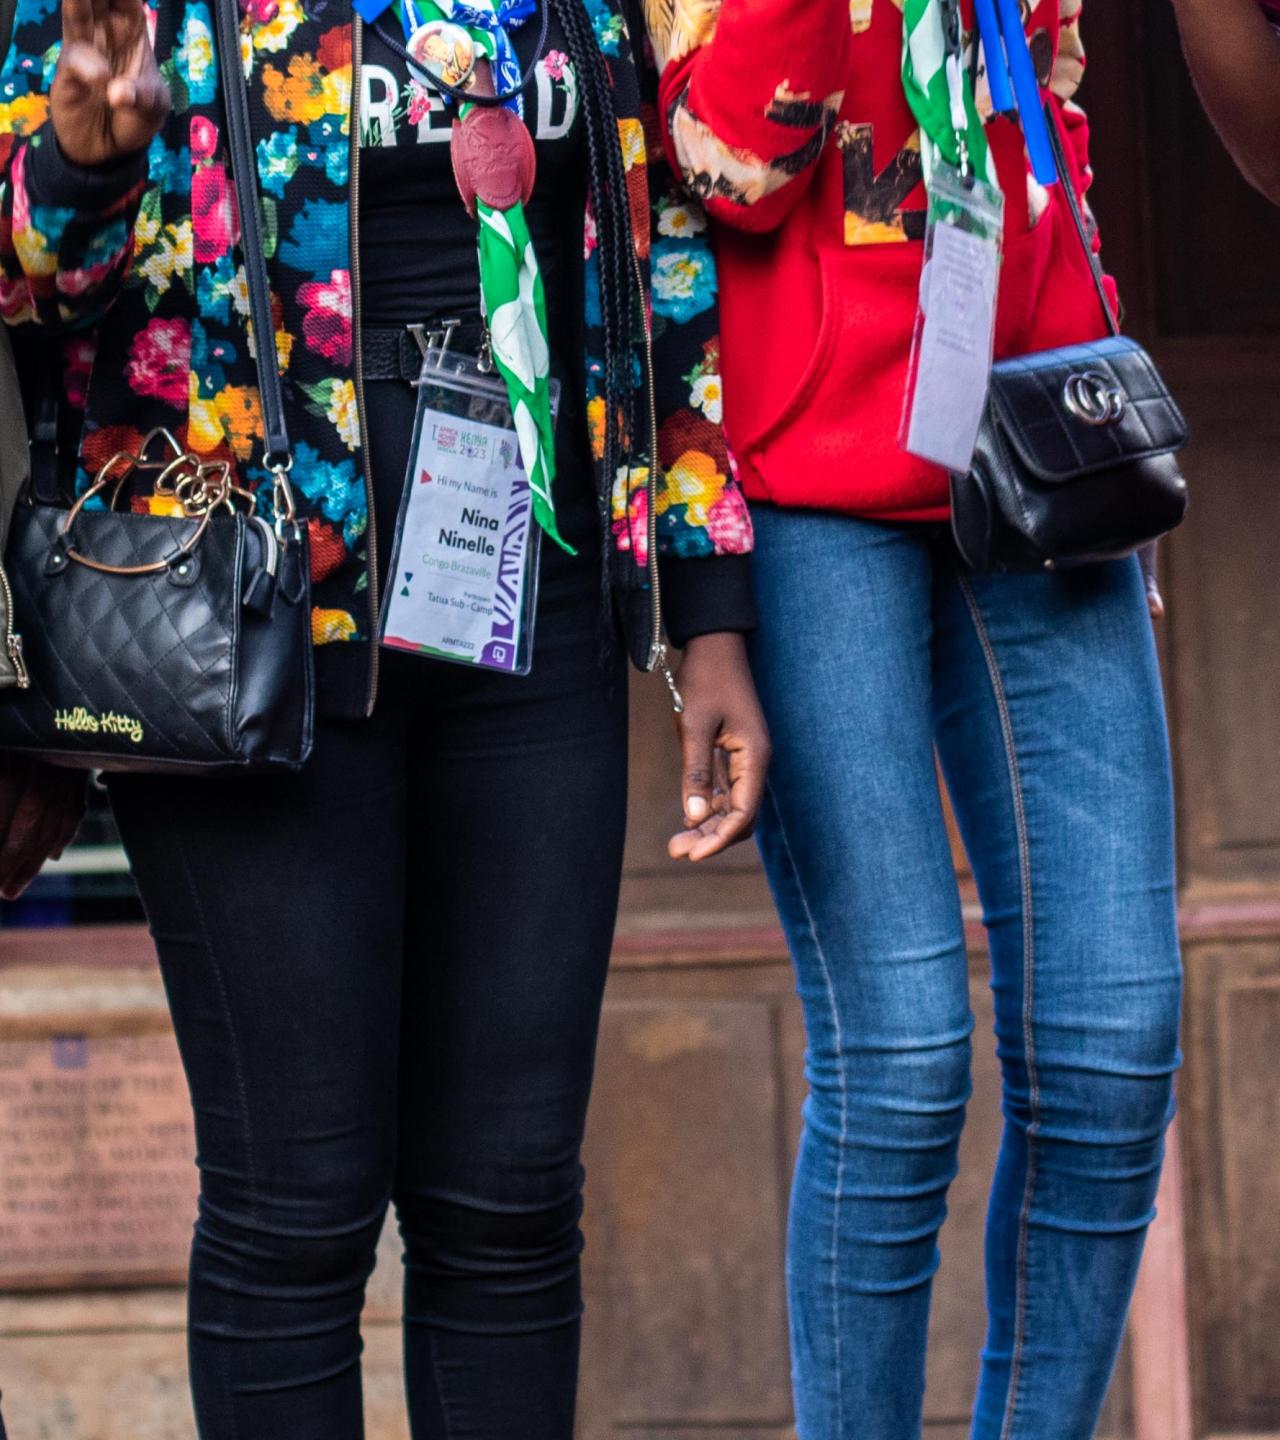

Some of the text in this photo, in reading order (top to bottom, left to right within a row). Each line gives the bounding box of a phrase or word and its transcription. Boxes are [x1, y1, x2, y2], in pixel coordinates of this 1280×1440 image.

[360, 59, 577, 148] RED
[460, 507, 500, 532] Nina
[438, 528, 496, 557] Ninelle
[422, 553, 451, 575] Congo
[470, 601, 494, 616] Camp
[54, 707, 144, 742] Hello Kitty
